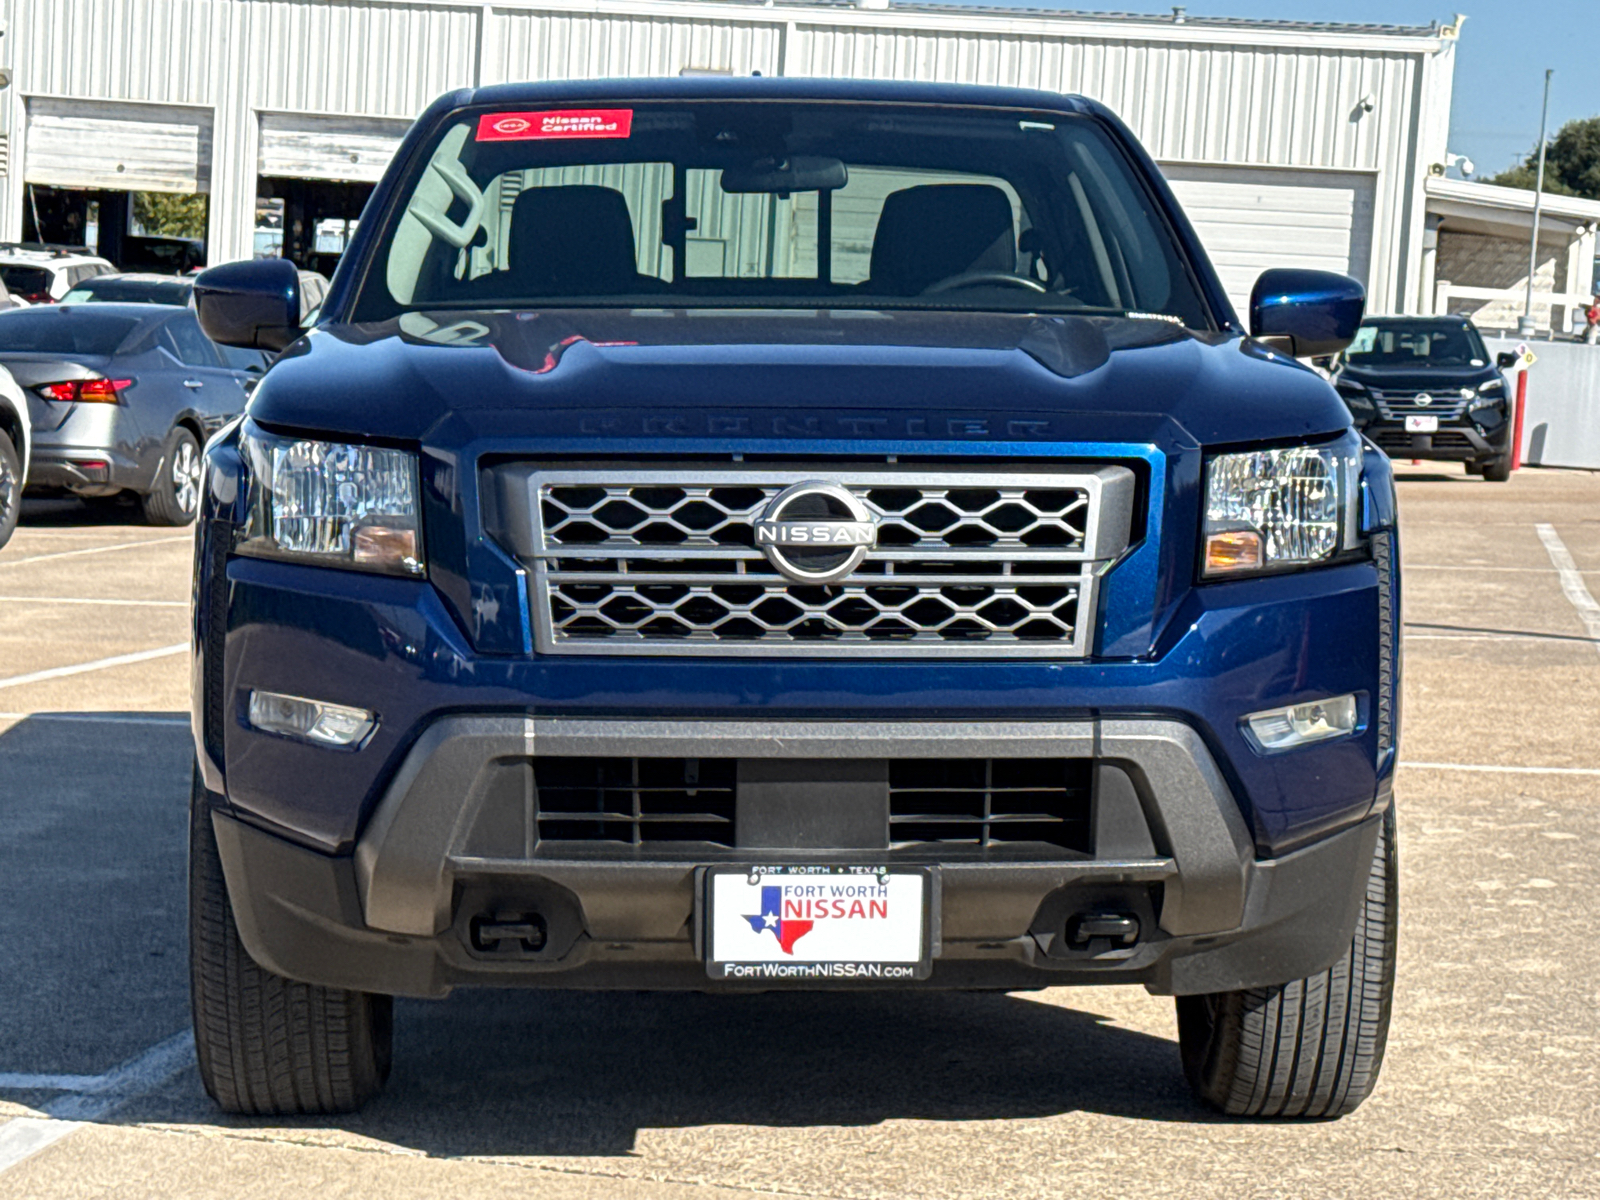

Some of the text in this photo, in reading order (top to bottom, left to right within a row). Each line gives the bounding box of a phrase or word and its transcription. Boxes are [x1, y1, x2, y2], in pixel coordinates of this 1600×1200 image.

[540, 122, 617, 132] Certified
[542, 116, 602, 125] Nissan
[579, 415, 1050, 436] FRONTIER
[758, 525, 874, 542] NISSAN
[751, 866, 887, 875] FORT WORTH TEXAS
[784, 885, 888, 898] FORT WORTH
[784, 899, 888, 919] NISSAN
